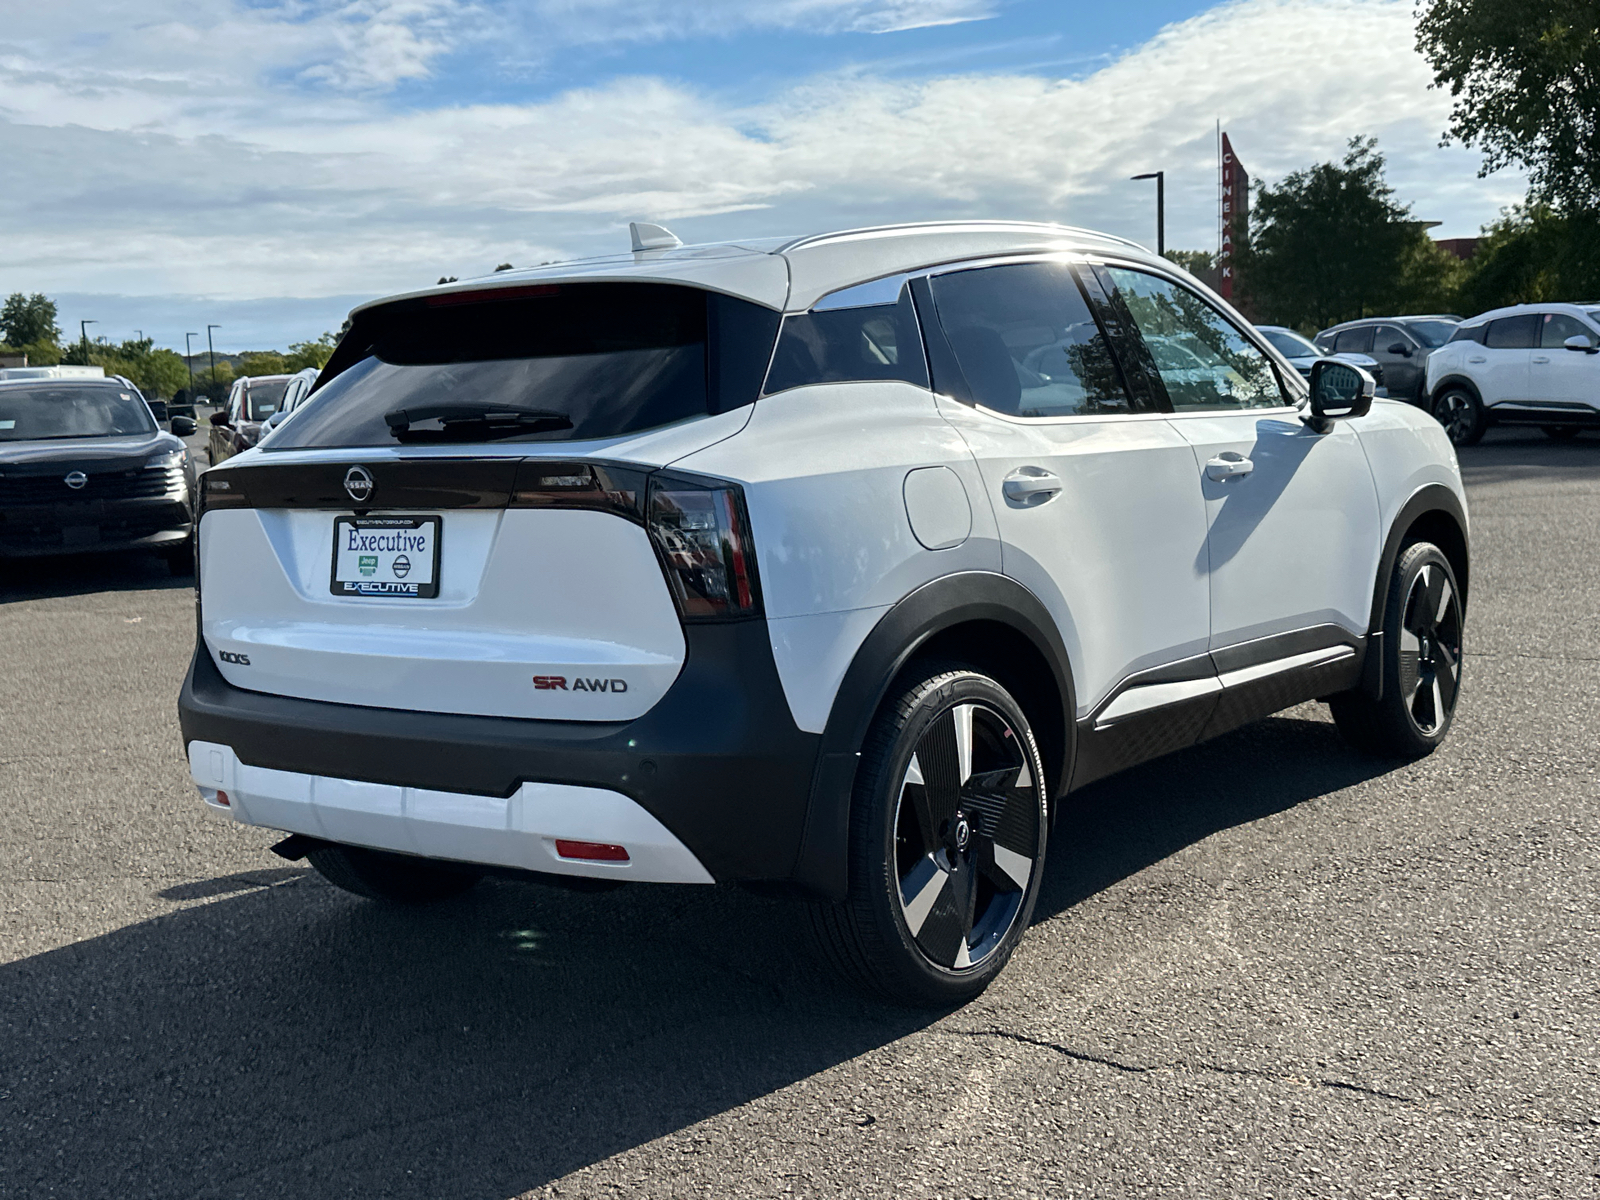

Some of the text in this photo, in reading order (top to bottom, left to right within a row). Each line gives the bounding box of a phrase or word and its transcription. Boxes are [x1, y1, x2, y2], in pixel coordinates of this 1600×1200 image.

[1222, 153, 1232, 278] CINEMARK
[347, 528, 426, 552] Executive
[361, 557, 376, 565] Jeep
[343, 582, 419, 593] EXECUTIVE
[532, 675, 628, 693] SR AWD
